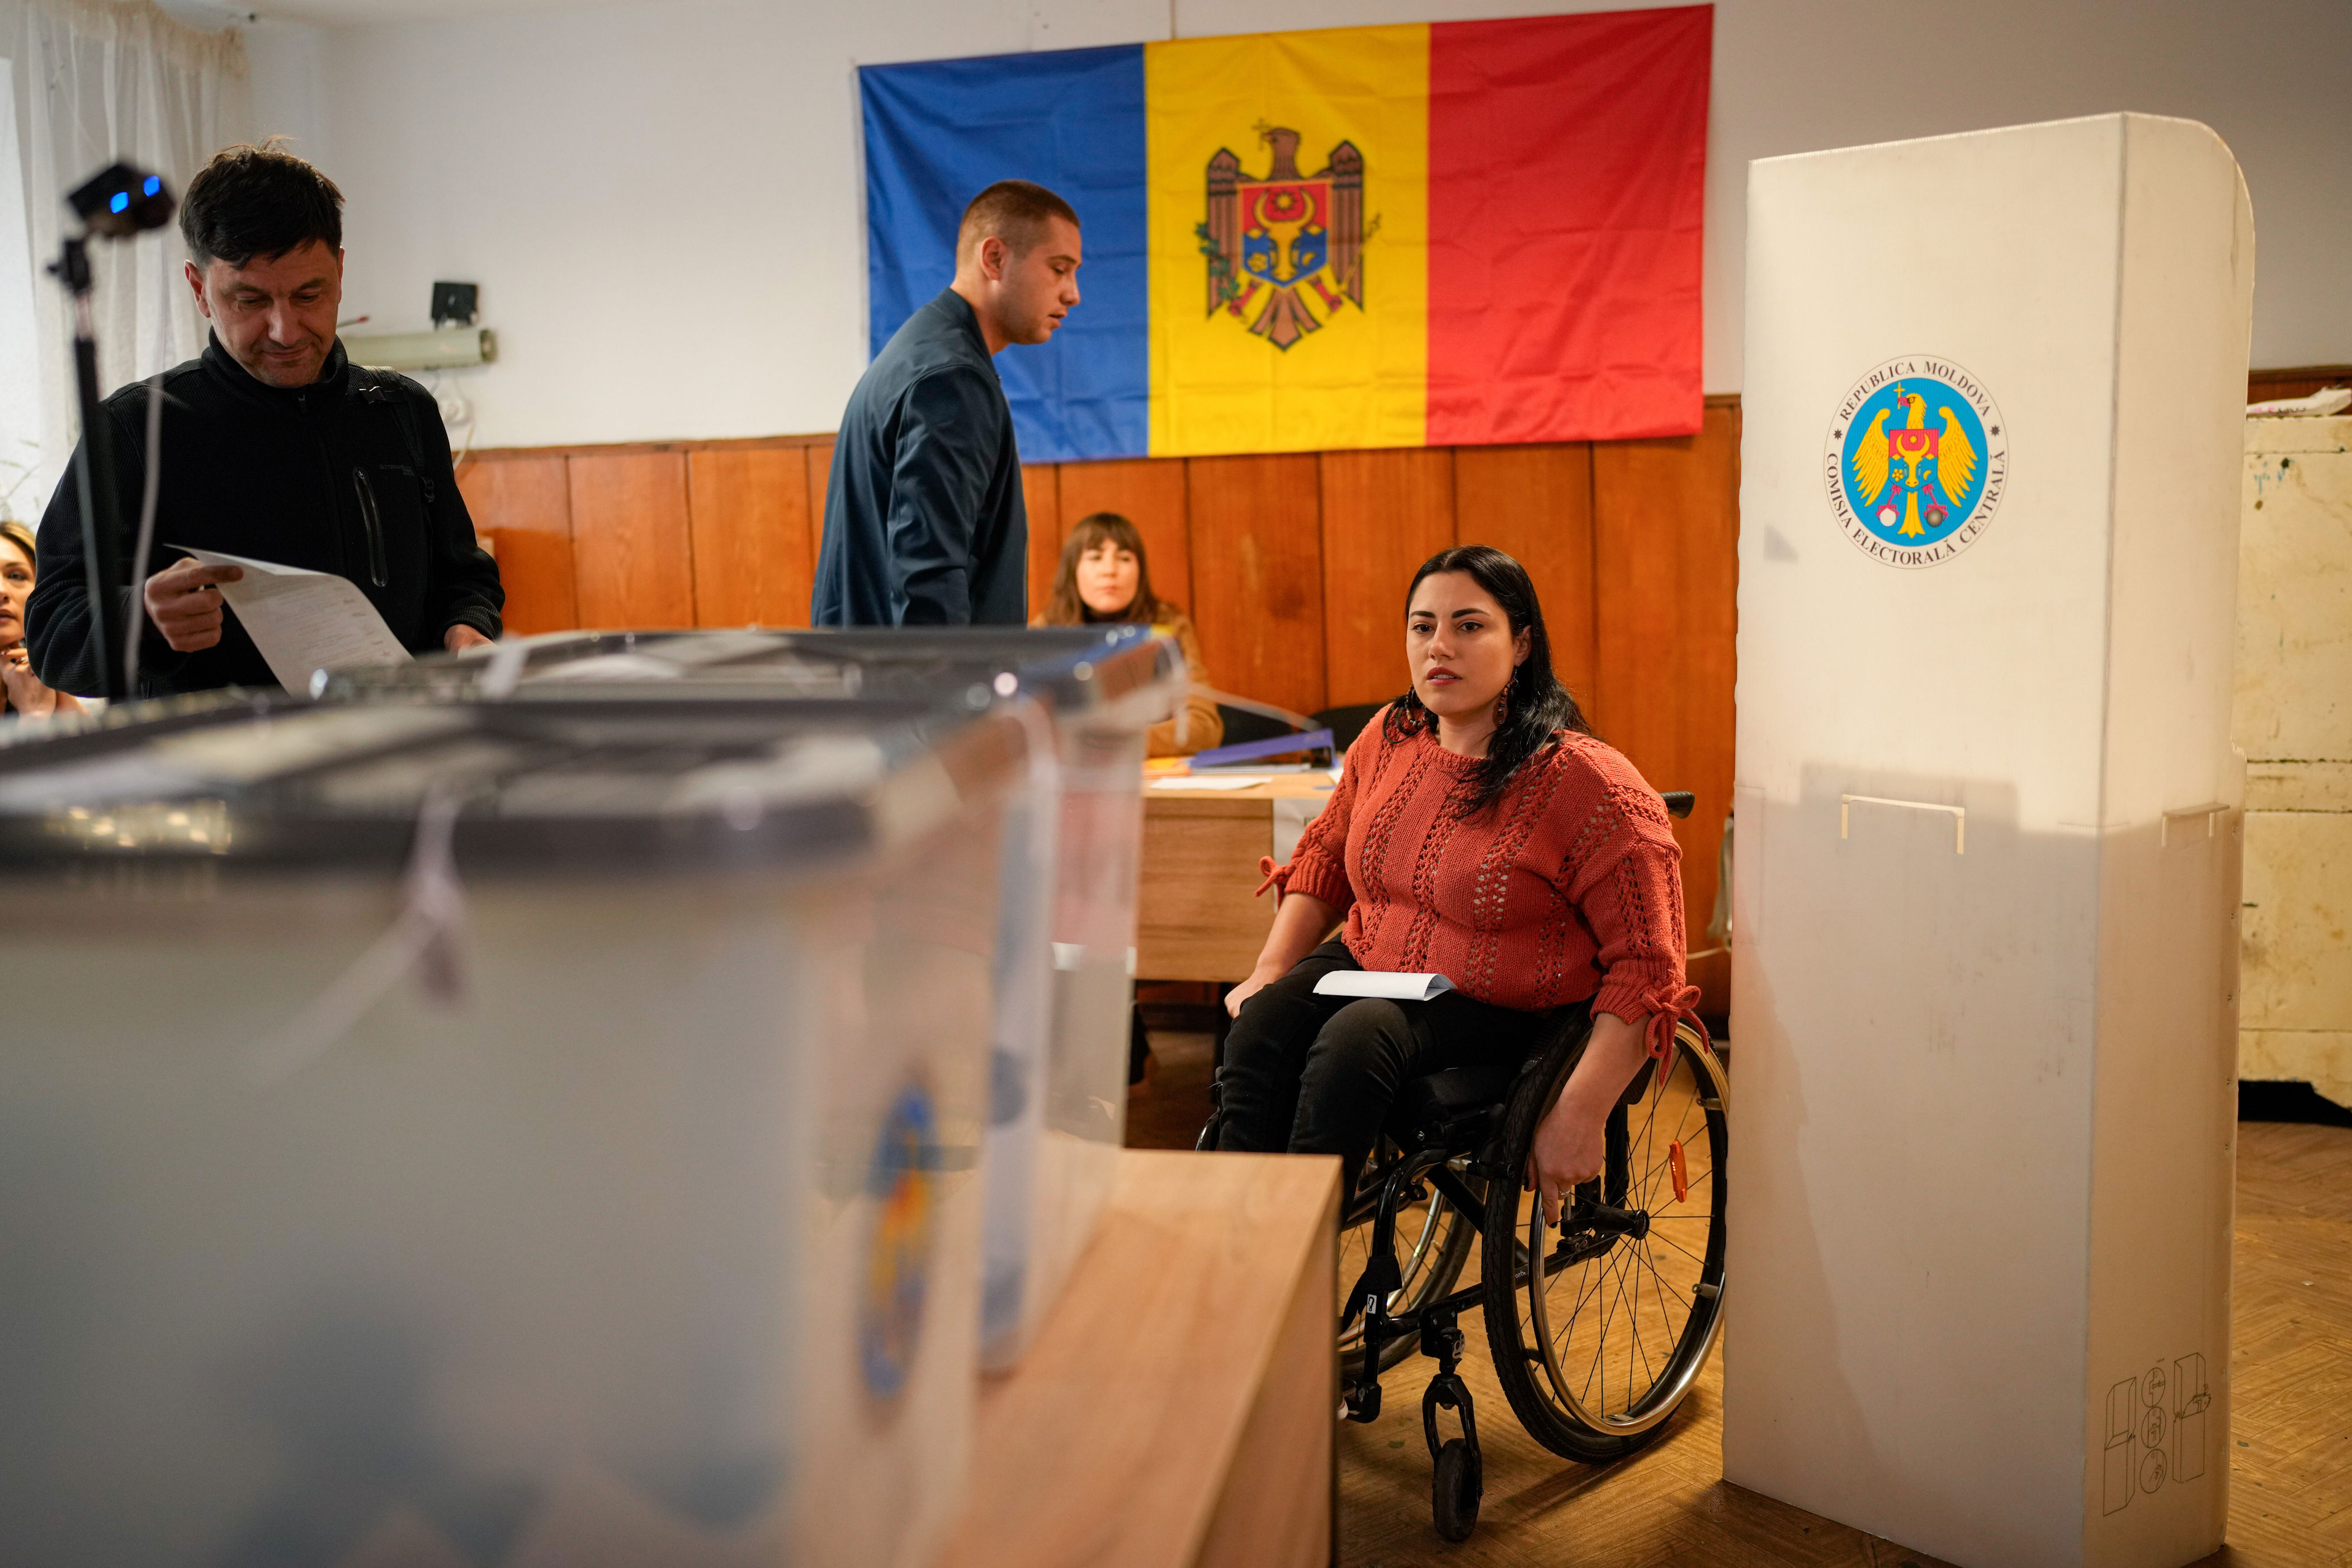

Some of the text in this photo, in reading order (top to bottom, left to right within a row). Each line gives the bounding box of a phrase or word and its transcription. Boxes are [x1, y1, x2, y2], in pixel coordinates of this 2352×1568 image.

[1840, 361, 1991, 421] REPUBLICA MOLDOVA
[1826, 450, 2005, 565] COMISIA ELECTORALĂ CENTRALĂ
